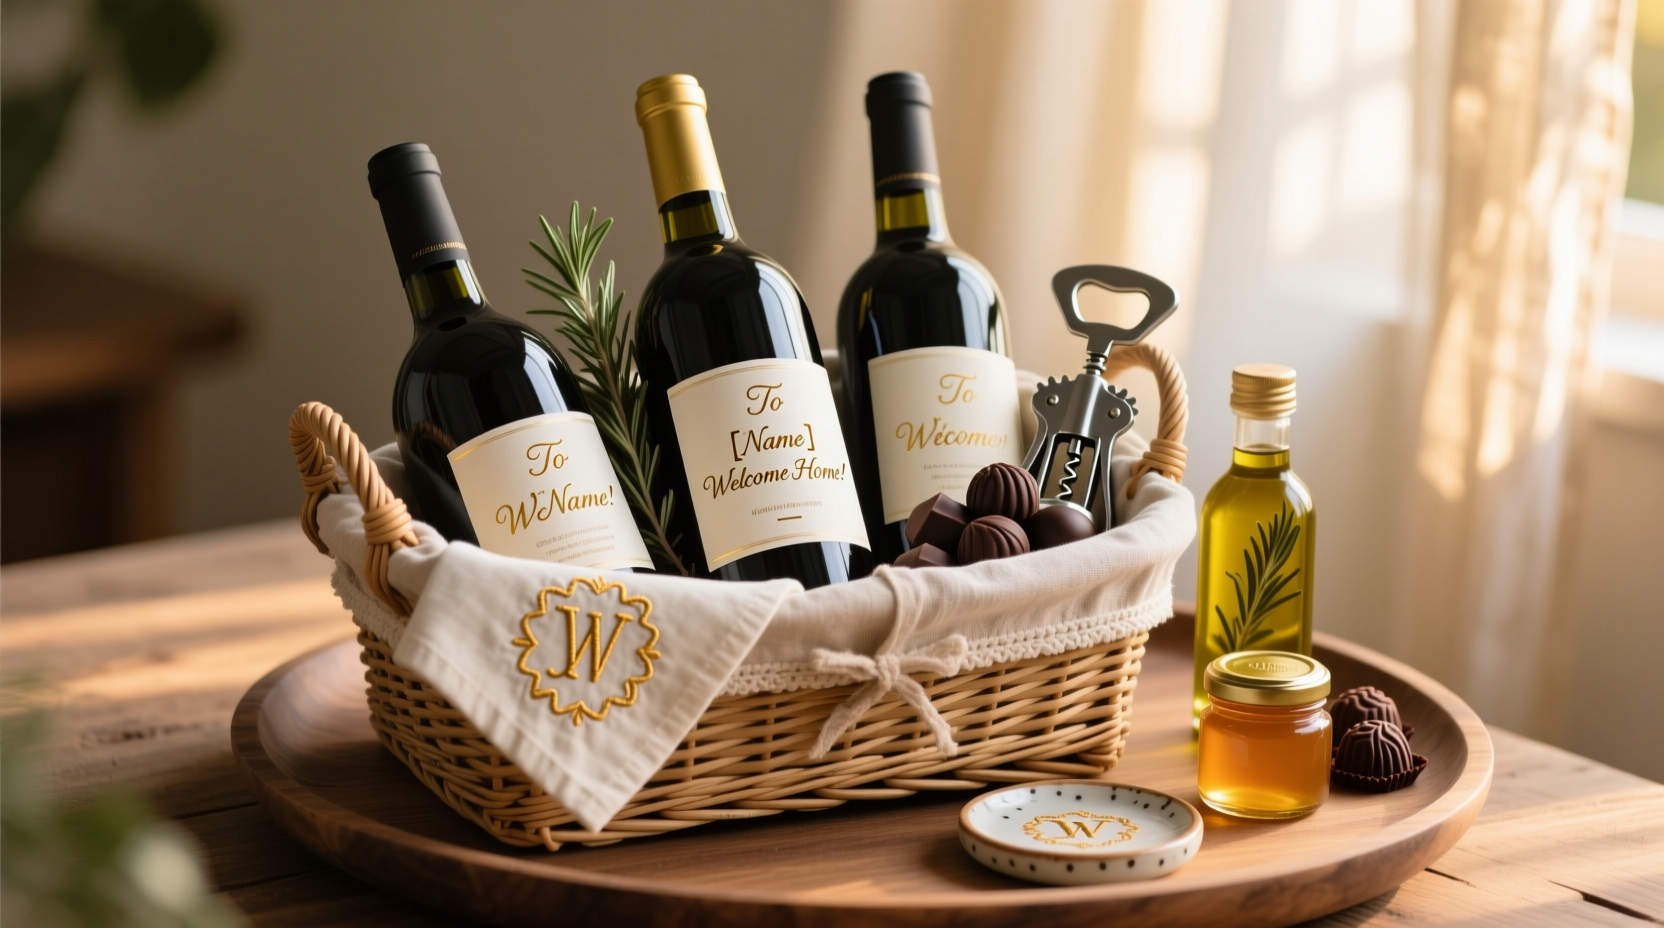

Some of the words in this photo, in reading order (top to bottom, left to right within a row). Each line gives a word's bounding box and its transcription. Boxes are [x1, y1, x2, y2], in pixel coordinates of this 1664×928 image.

[746, 382, 784, 416] To
[937, 373, 977, 405] To
[526, 438, 569, 477] To
[730, 423, 816, 462] [Name]
[703, 467, 790, 499] Welcome
[791, 456, 846, 481] Home!
